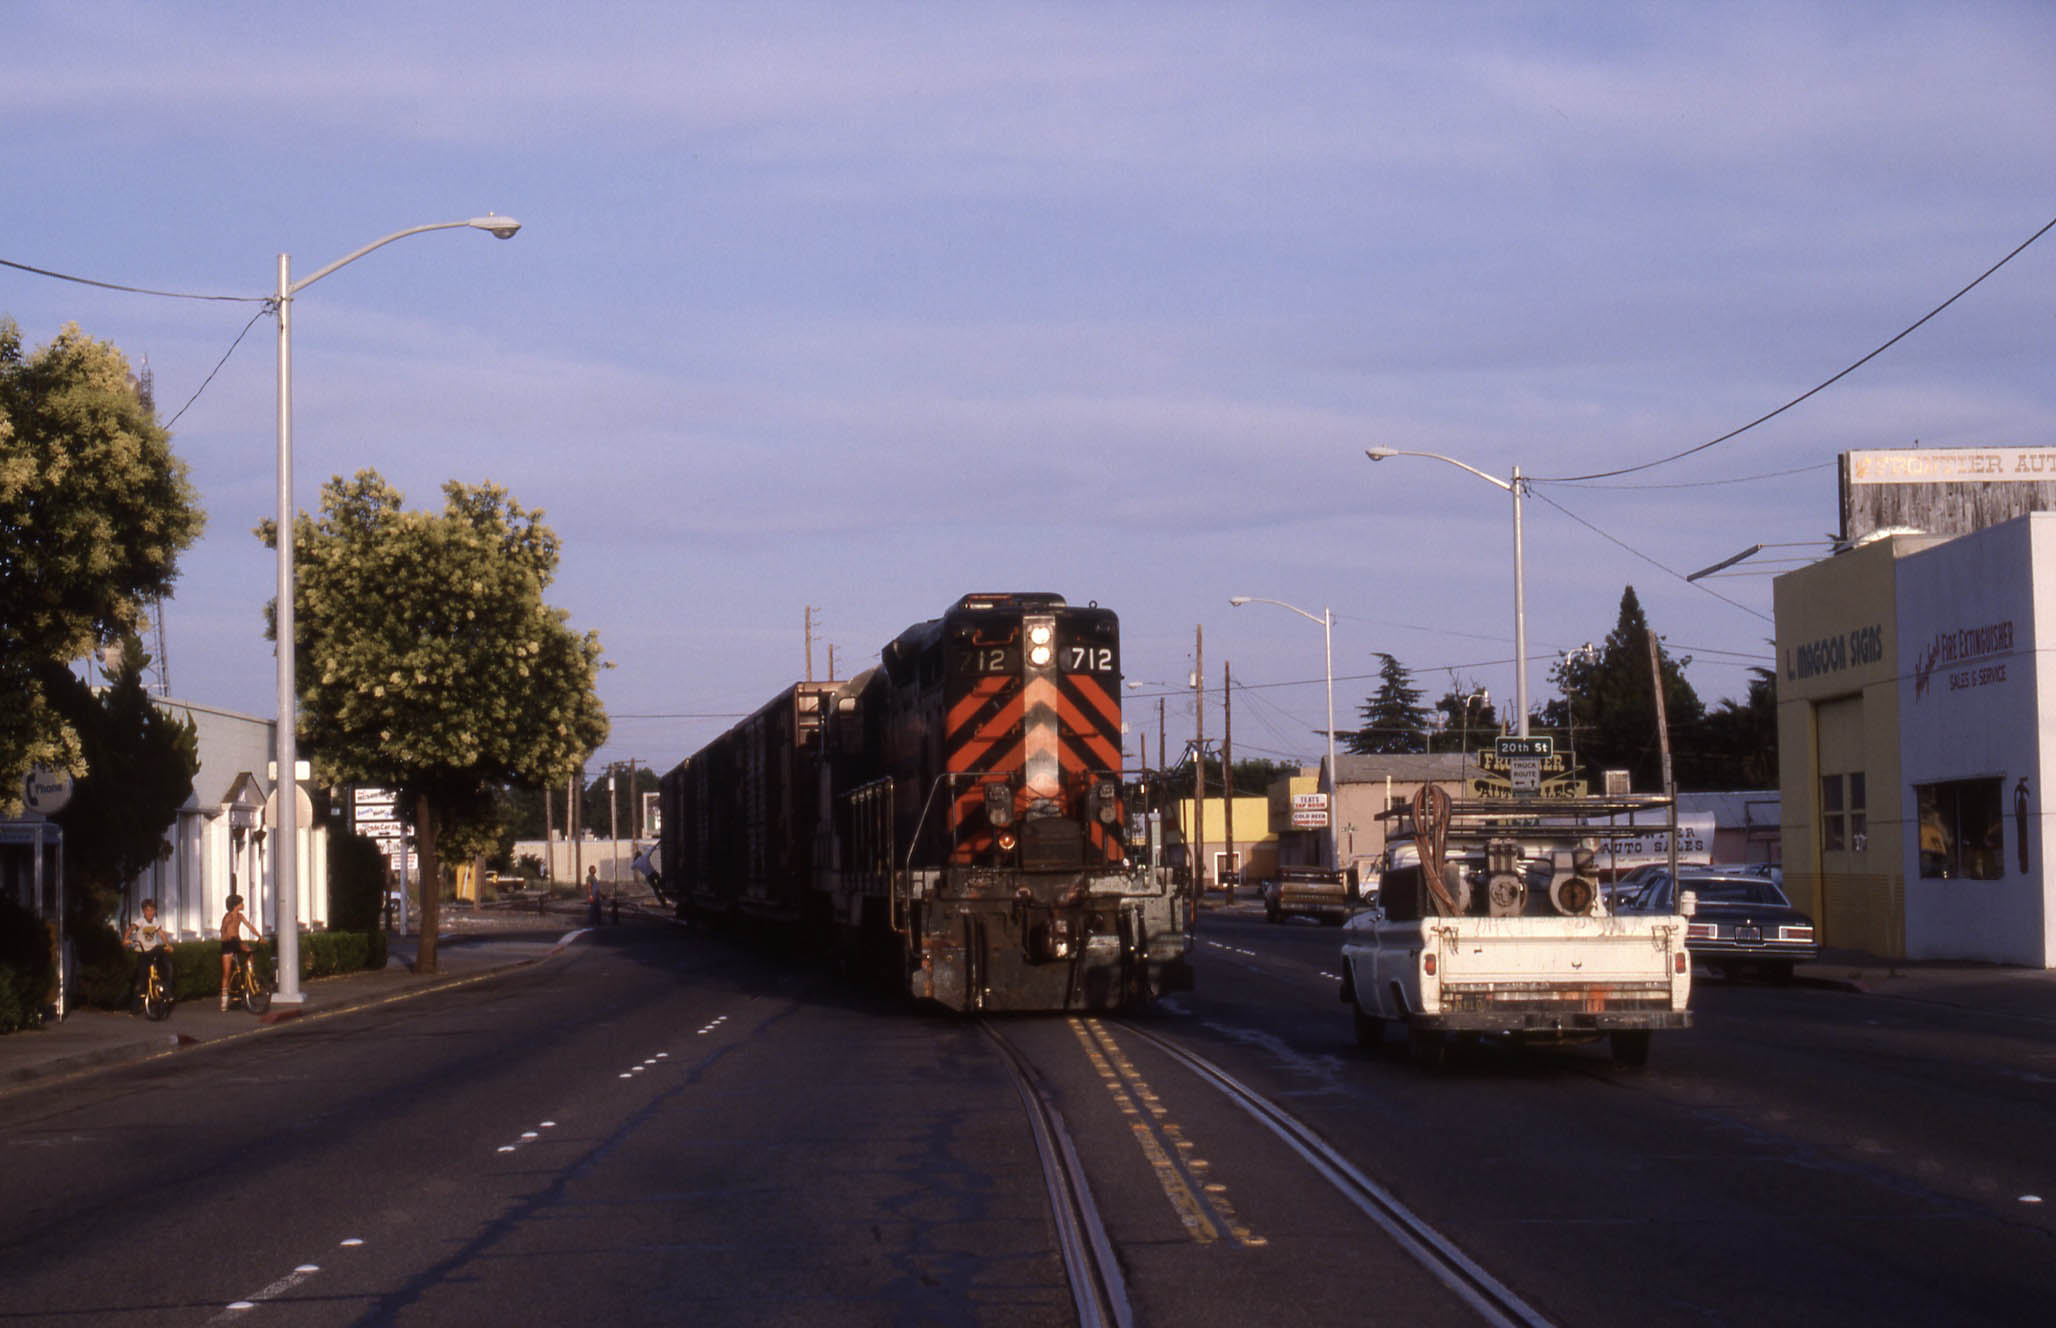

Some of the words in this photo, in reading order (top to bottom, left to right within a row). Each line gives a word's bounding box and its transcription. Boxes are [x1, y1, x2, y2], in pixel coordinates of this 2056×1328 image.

[1942, 632, 1958, 662] FIRE
[1959, 621, 2014, 658] EXTINGUISHER
[1072, 648, 1112, 671] 712
[1950, 671, 1969, 690] SALES
[1979, 665, 2007, 686] SERVICE
[1501, 743, 1529, 752] 20th
[1535, 743, 1548, 752] St
[35, 783, 63, 794] Phone
